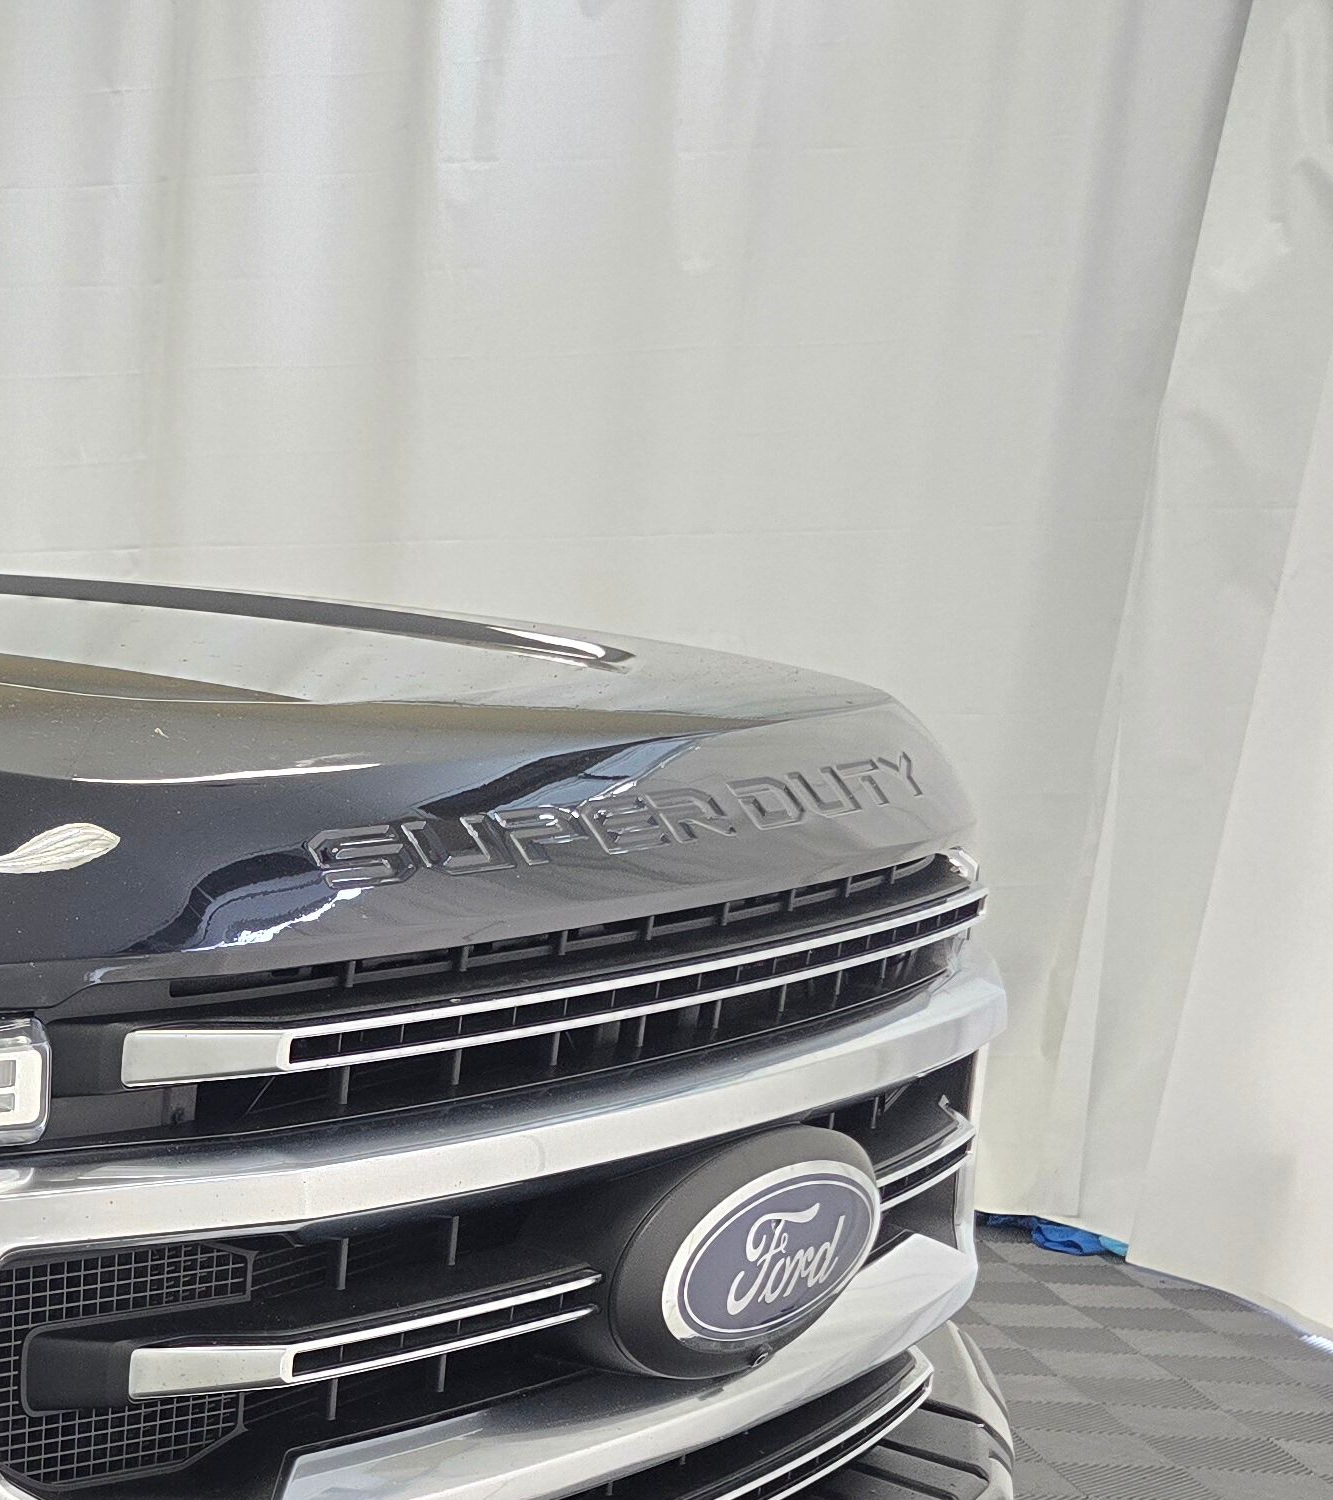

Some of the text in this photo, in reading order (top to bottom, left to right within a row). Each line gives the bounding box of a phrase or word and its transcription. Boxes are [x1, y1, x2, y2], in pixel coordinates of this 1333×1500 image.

[304, 750, 923, 888] SUPER DUTY
[726, 1202, 845, 1316] Ford
